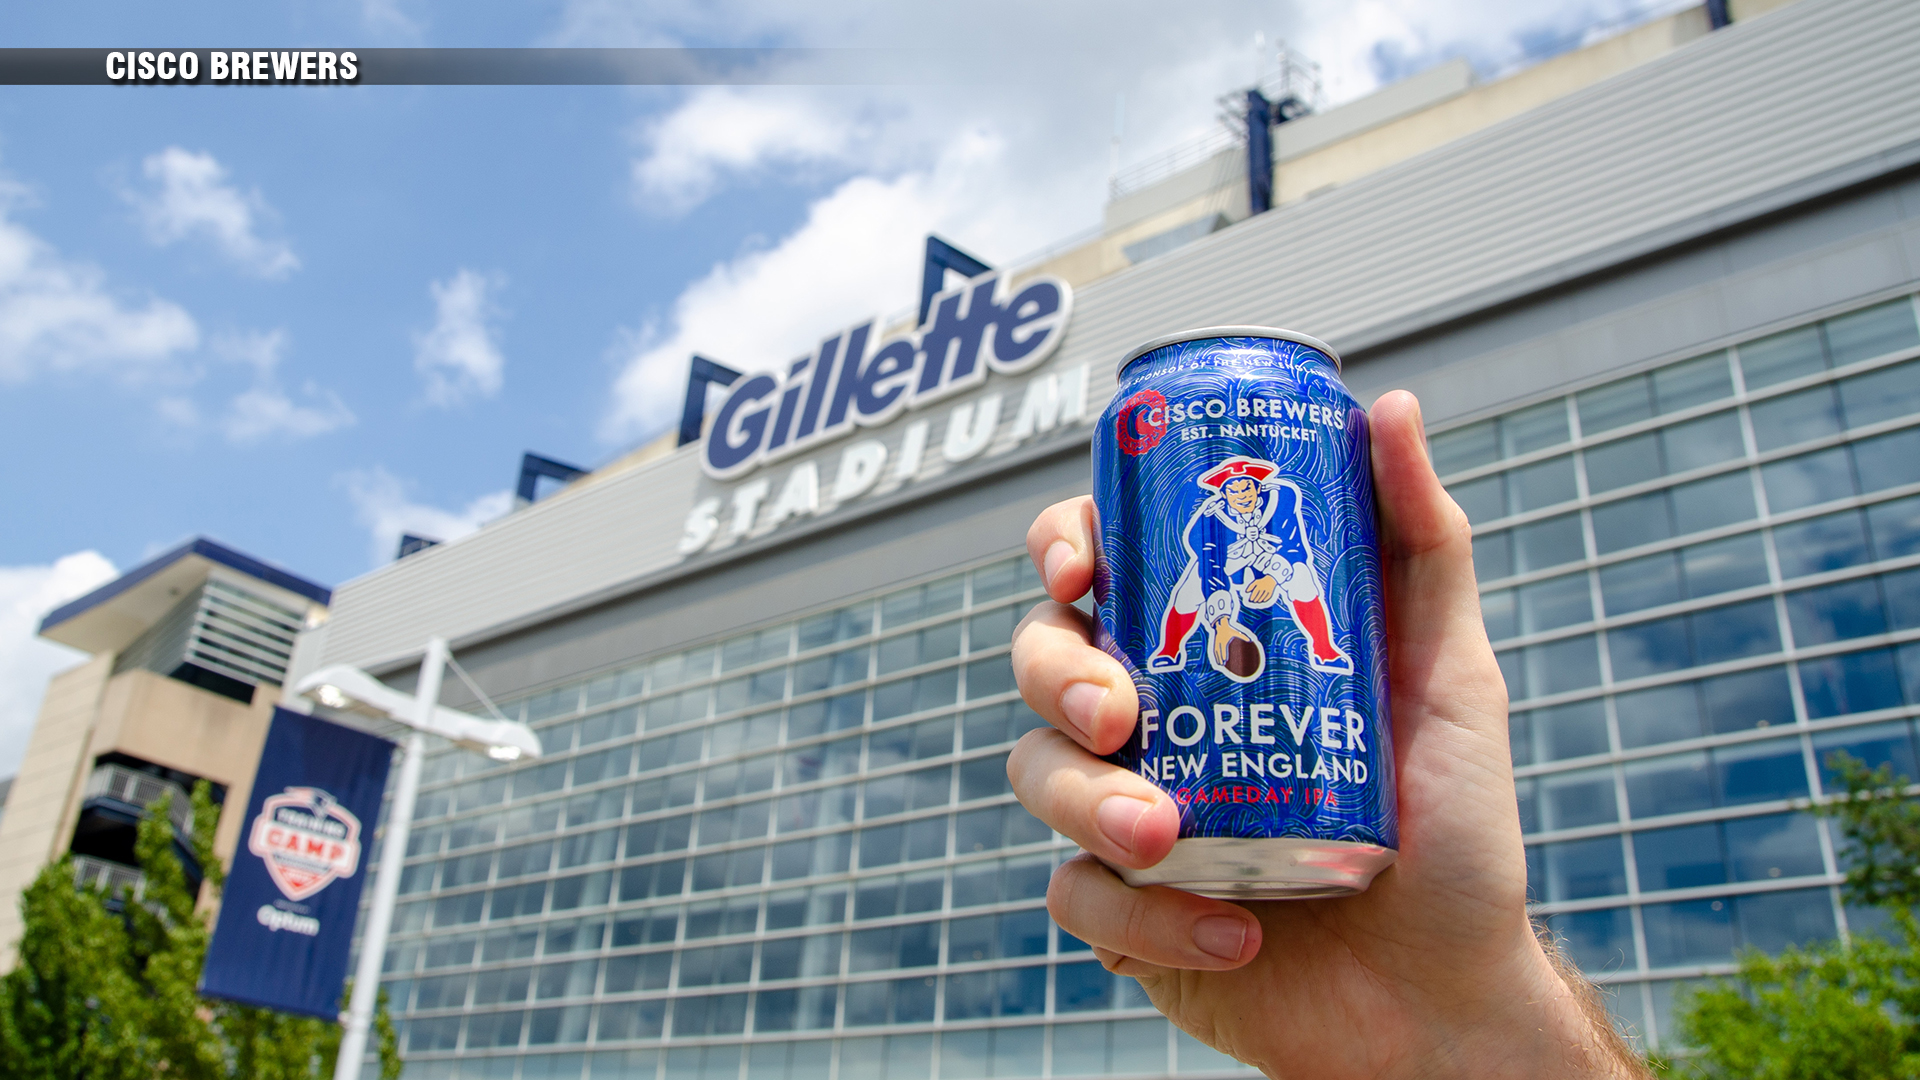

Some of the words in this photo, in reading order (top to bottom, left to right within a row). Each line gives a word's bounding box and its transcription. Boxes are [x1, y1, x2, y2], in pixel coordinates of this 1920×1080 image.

[703, 273, 1073, 479] Gillette
[1132, 364, 1184, 386] SPONSOR
[1190, 360, 1207, 370] OF
[1148, 398, 1226, 427] CISCO
[1236, 398, 1344, 431] BREWERS
[1181, 427, 1213, 442] EST.
[1220, 424, 1317, 442] NANTUCKET
[677, 362, 1090, 556] STADIUM
[1141, 703, 1367, 752] FOREVER
[1140, 753, 1208, 780] NEW
[1221, 752, 1368, 784] ENGLAND
[1176, 786, 1293, 804] GAMEDAY
[1304, 788, 1338, 806] IPA
[267, 828, 344, 862] CAMP
[256, 904, 321, 938] Optum
